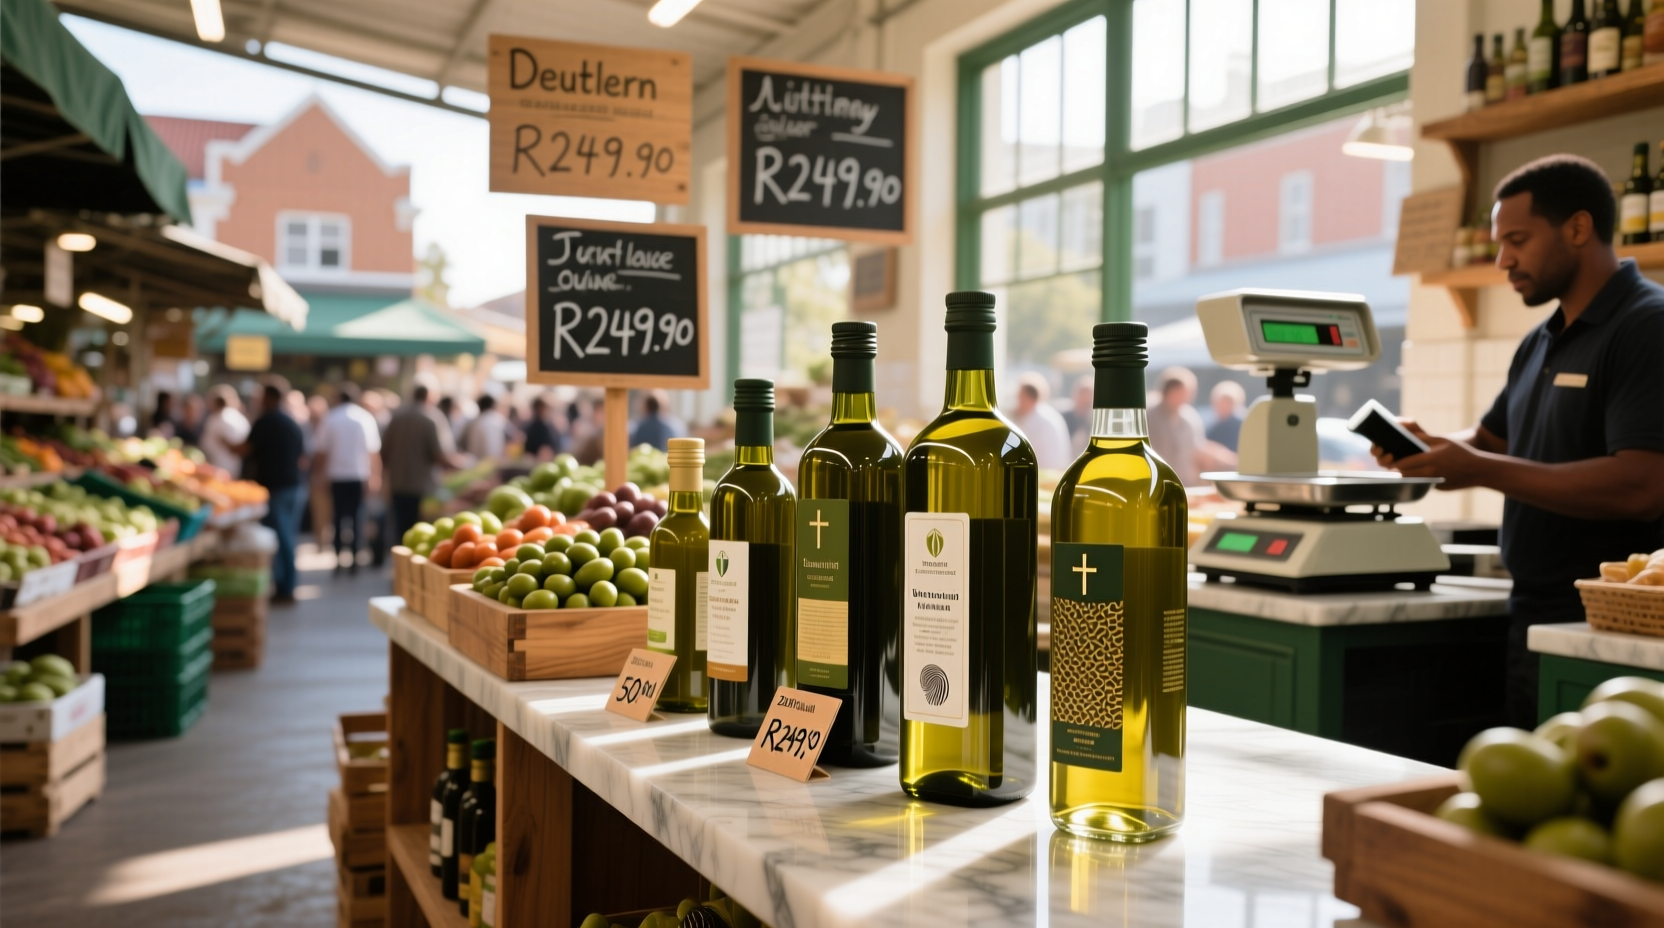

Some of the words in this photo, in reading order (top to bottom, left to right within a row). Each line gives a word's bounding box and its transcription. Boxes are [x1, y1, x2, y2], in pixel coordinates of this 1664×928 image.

[509, 47, 658, 100] Deutlern
[512, 124, 675, 179] R249.90
[753, 145, 902, 210] R249.90
[553, 301, 695, 360] R249.90
